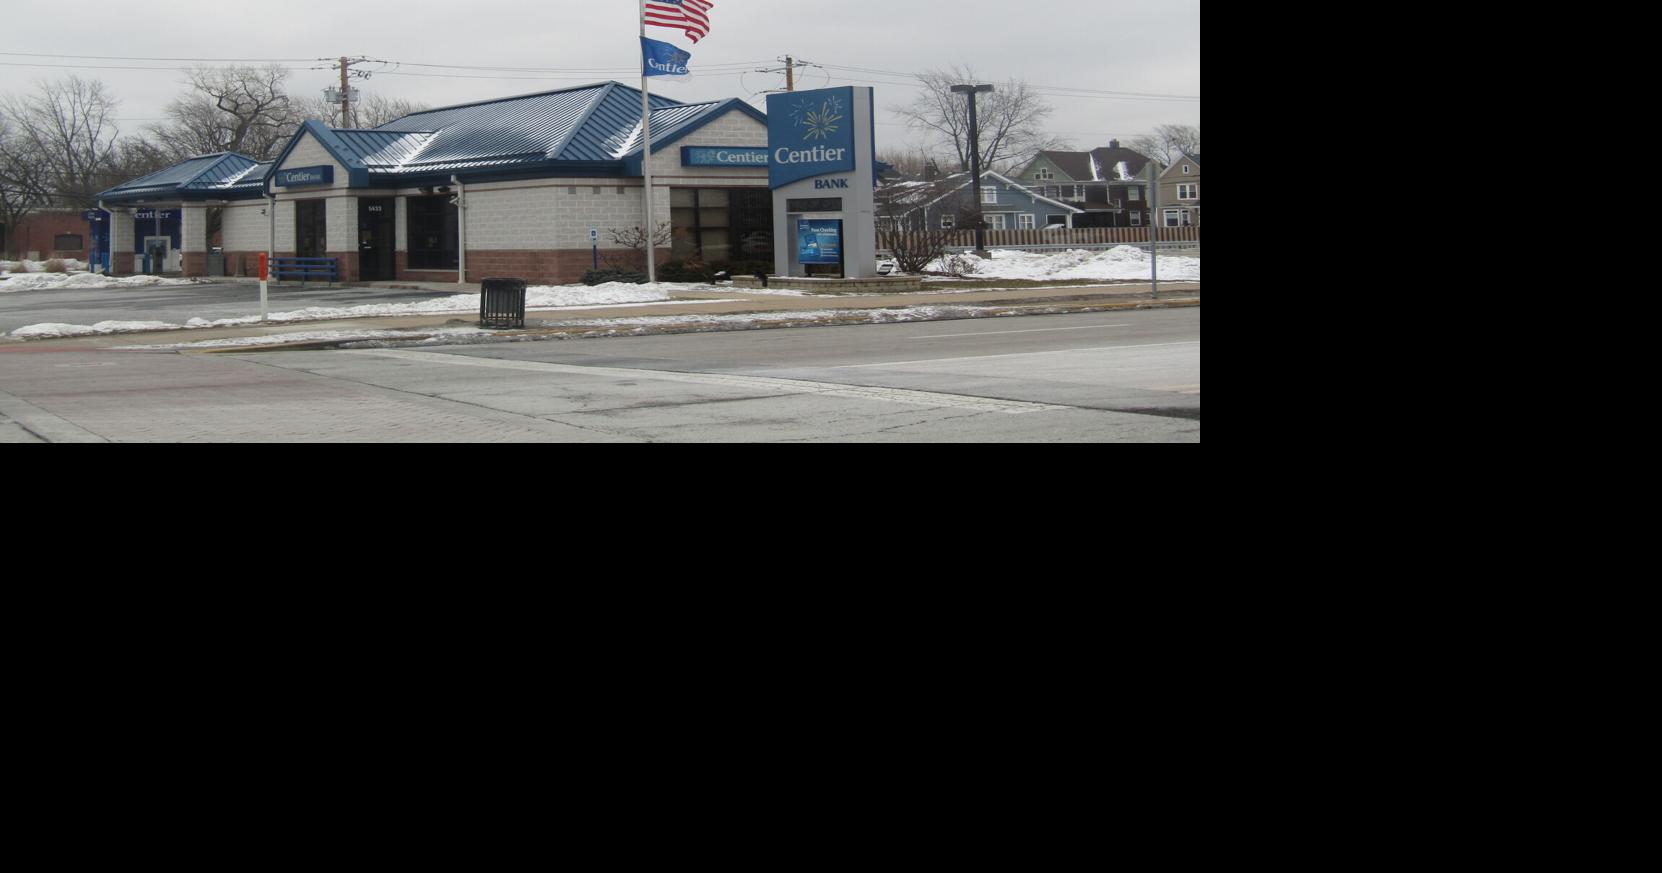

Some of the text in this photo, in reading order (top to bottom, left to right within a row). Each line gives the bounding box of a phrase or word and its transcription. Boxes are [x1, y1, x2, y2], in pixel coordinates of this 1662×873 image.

[716, 151, 768, 163] Centier
[774, 145, 846, 164] Centier
[287, 171, 311, 183] Centier
[814, 179, 848, 189] BANK
